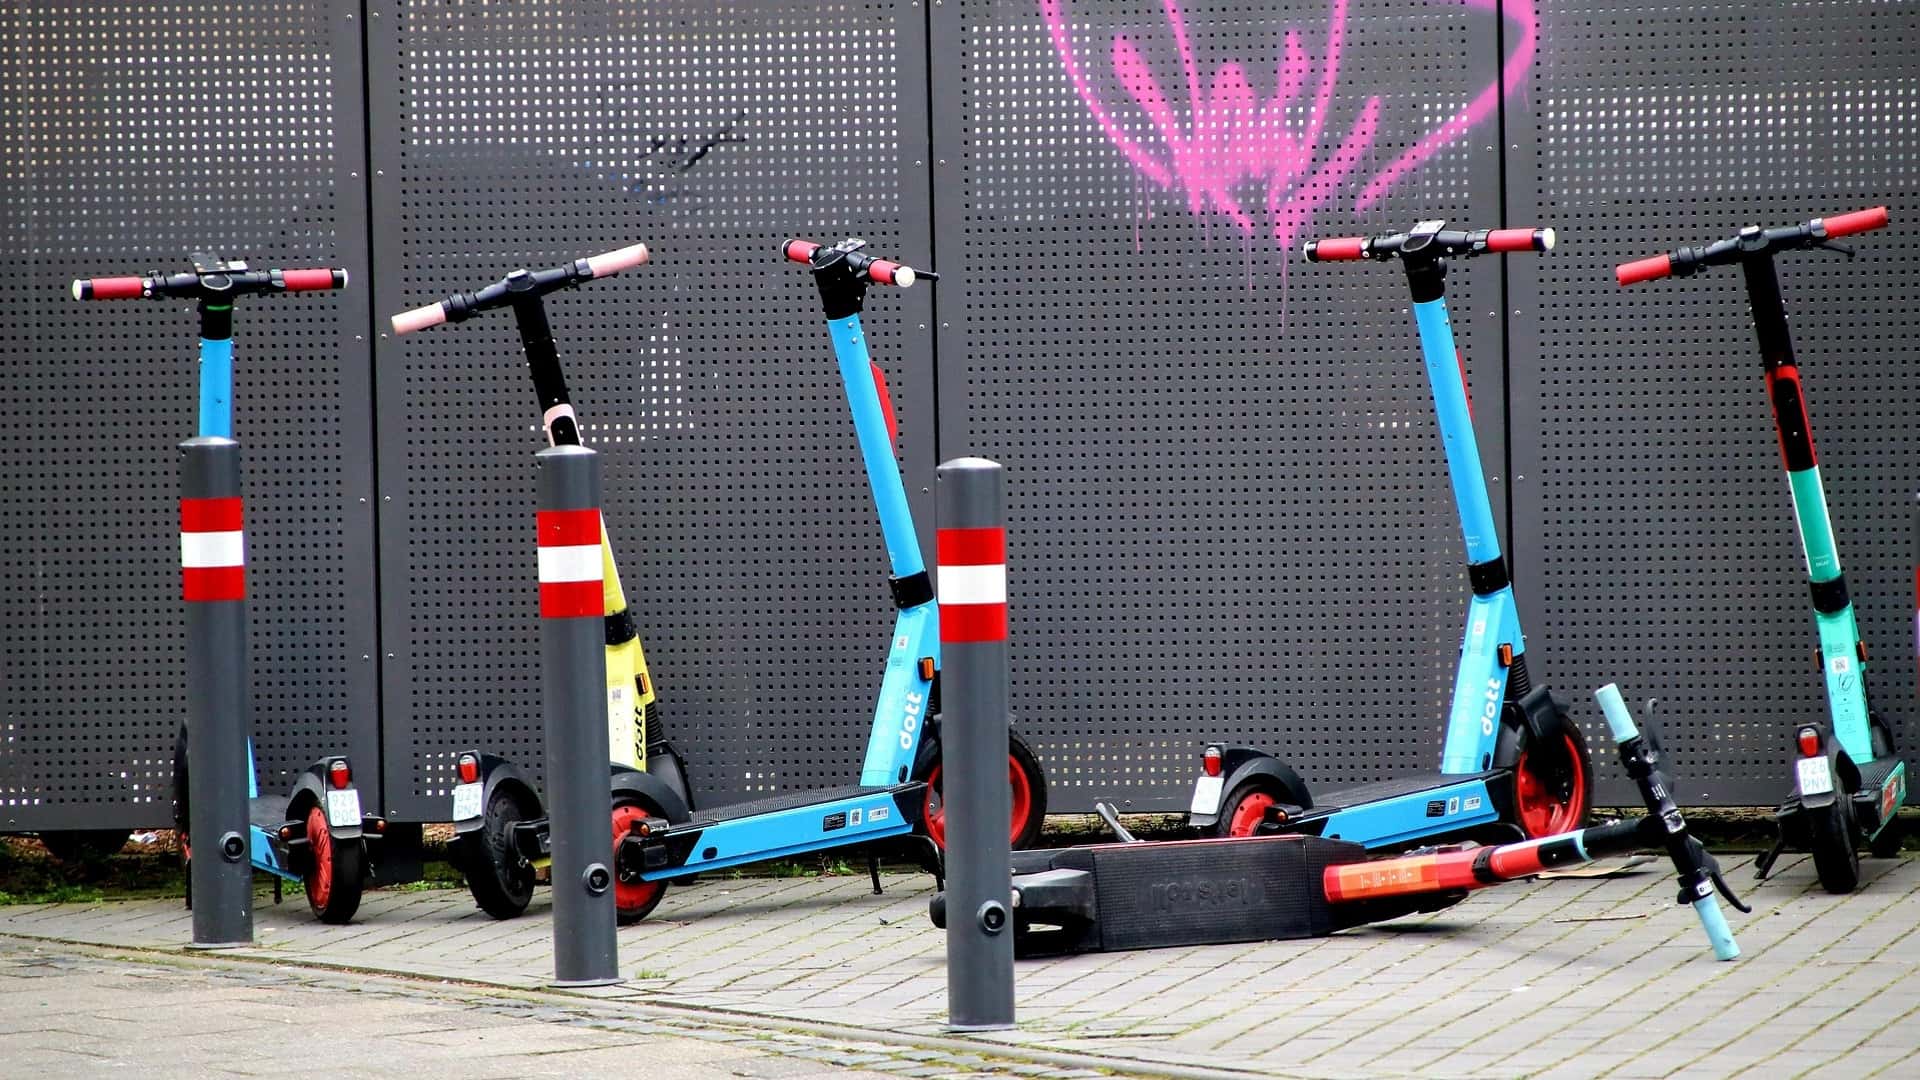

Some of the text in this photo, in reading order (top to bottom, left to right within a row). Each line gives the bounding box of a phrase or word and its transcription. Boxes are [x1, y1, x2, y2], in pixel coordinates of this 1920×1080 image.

[634, 706, 643, 761] dott
[899, 690, 923, 750] dott
[1481, 677, 1501, 736] dott
